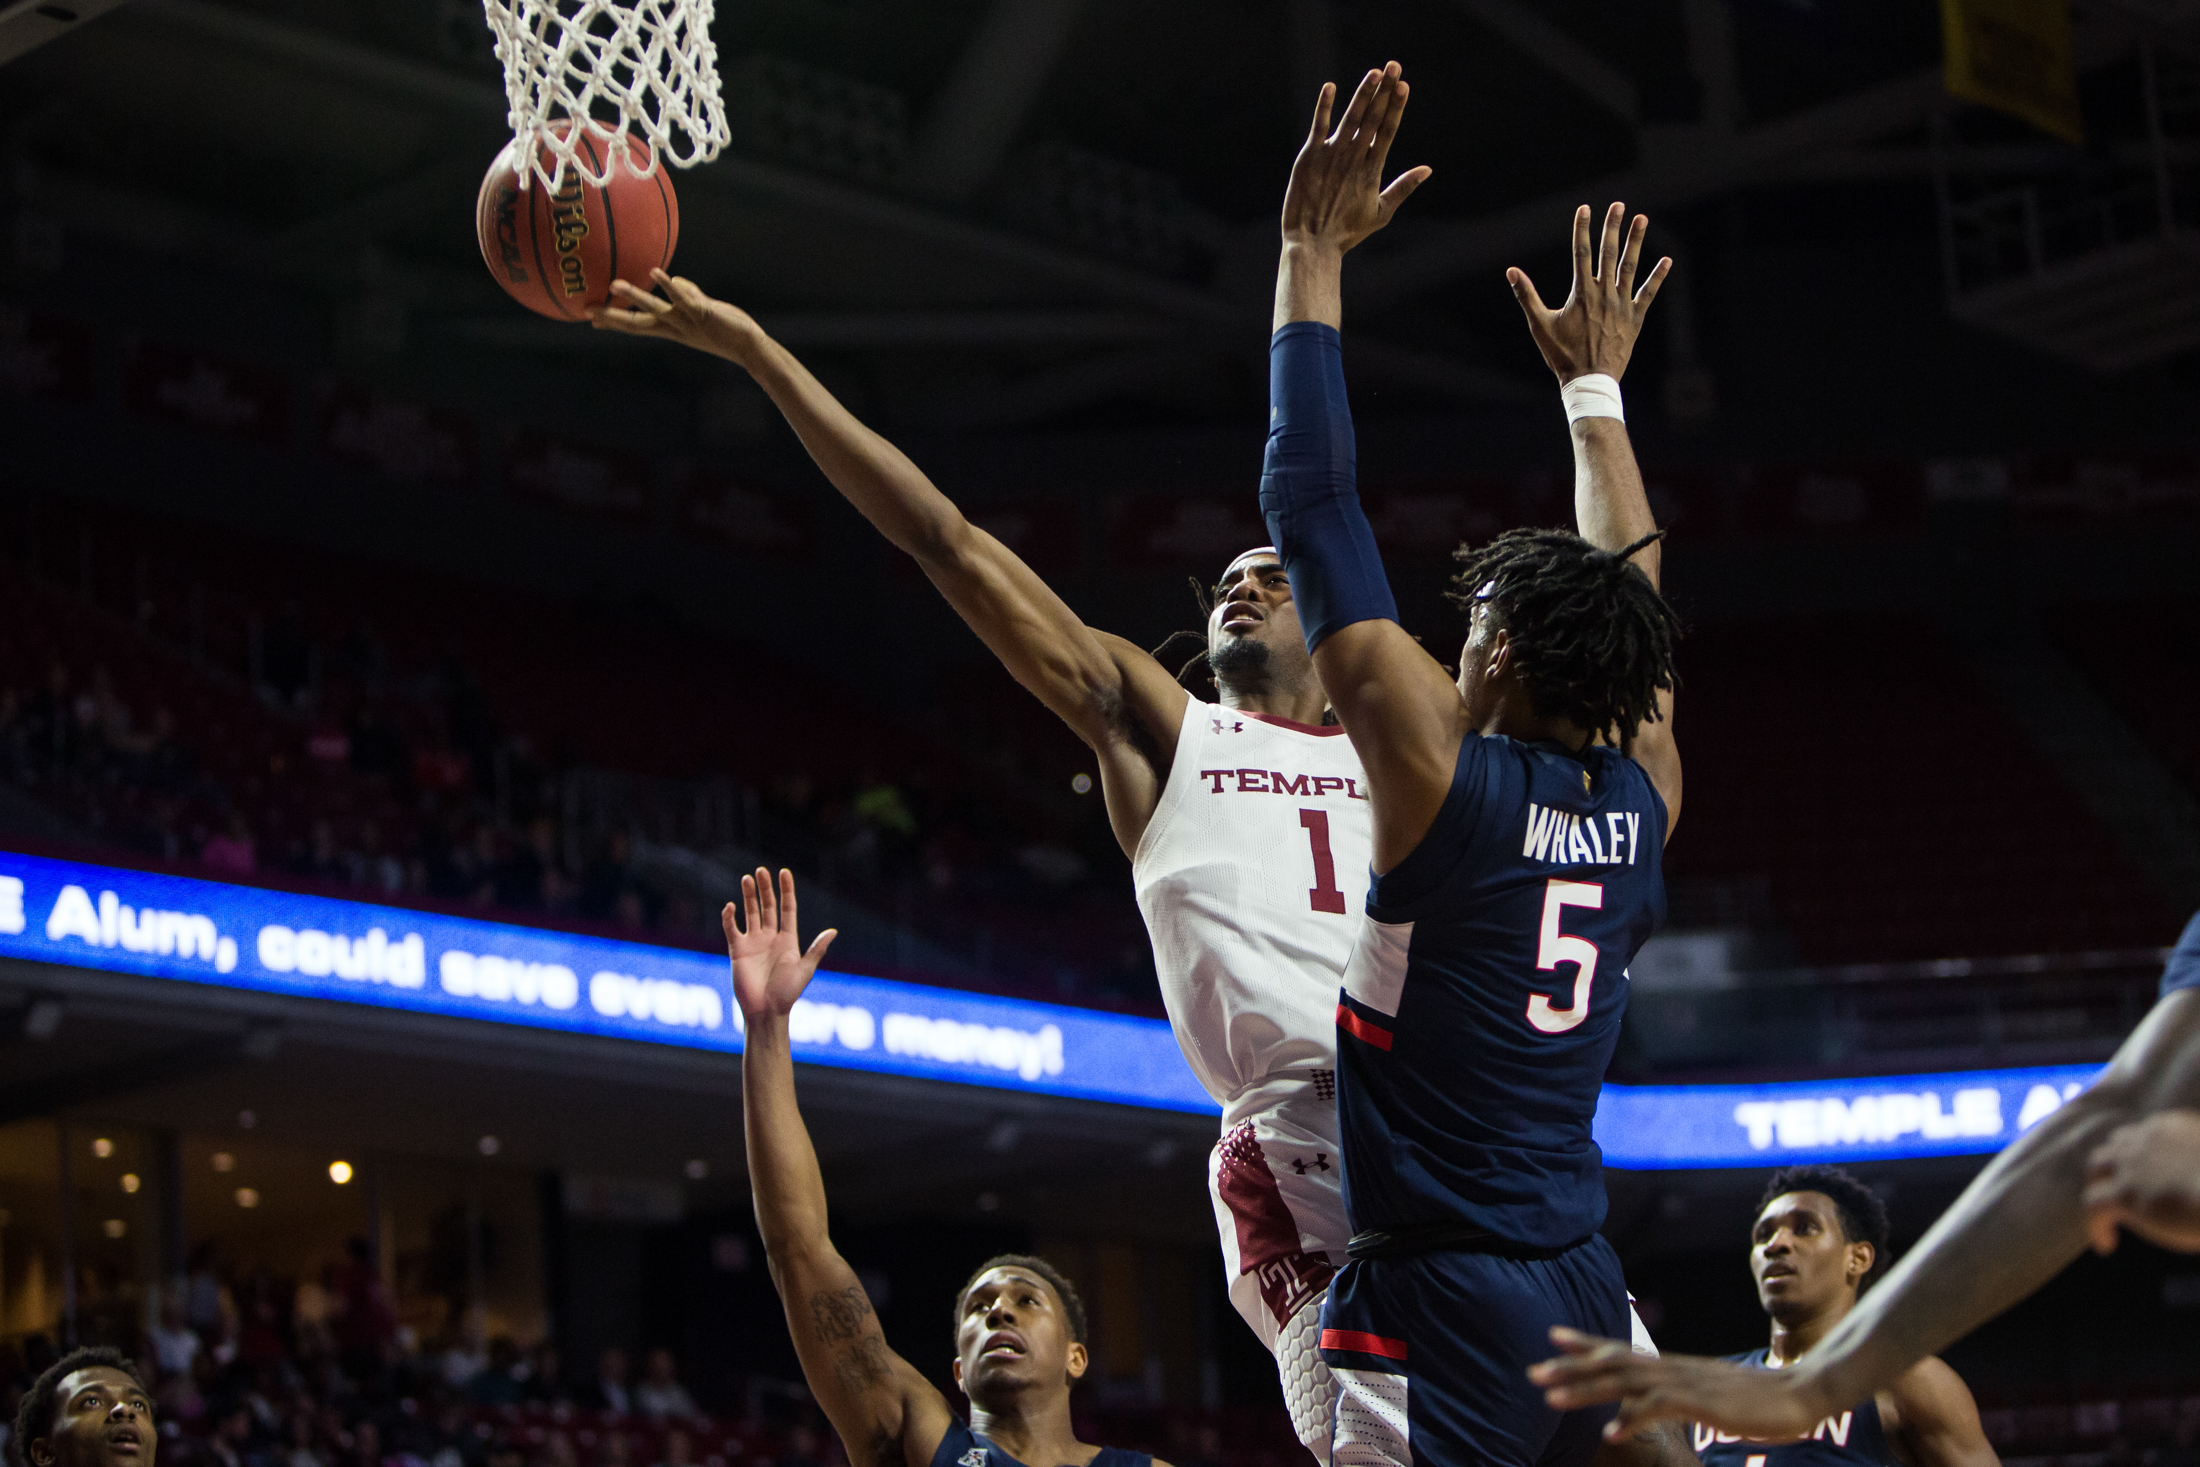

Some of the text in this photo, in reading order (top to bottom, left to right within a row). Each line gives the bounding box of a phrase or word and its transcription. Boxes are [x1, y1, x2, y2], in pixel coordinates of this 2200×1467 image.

[497, 185, 529, 283] NCAA
[1200, 768, 1370, 801] TEMPL
[1298, 808, 1347, 915] 1
[1522, 802, 1640, 866] WHALEY
[46, 885, 238, 974] Alum,
[257, 925, 426, 989] could
[732, 995, 875, 1051] ore
[882, 1012, 1065, 1081] money!
[1525, 877, 1604, 1035] 5
[1733, 1087, 2003, 1150] TEMPLE
